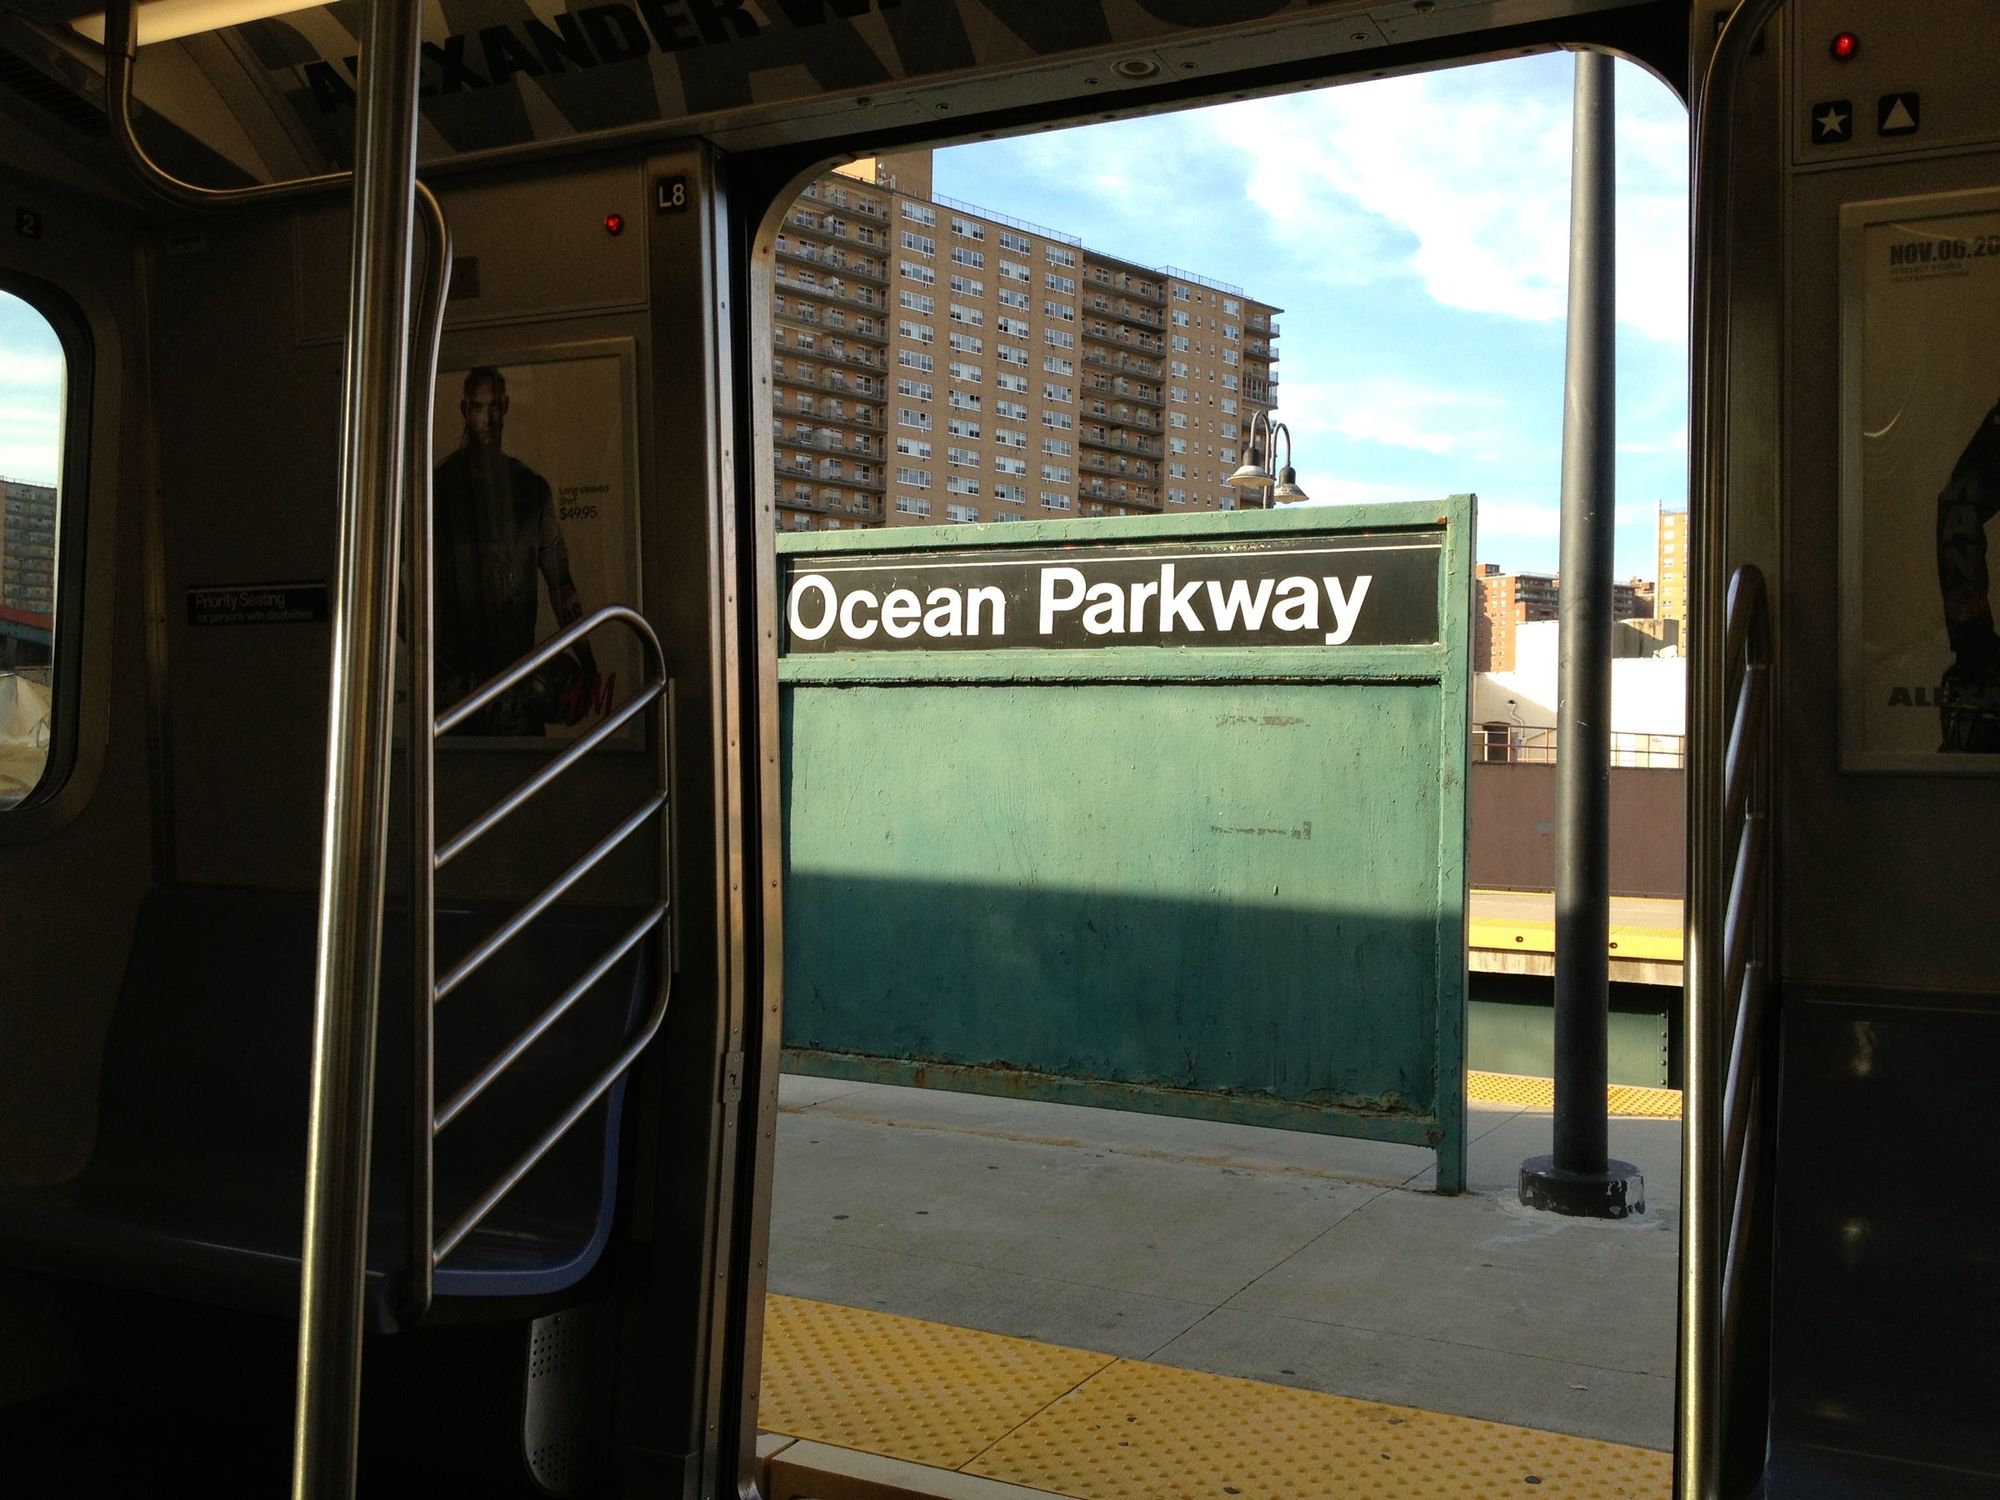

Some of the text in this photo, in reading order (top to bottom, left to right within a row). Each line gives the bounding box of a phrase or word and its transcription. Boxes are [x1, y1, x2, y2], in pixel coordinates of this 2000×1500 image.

[304, 0, 762, 114] AXANDER
[658, 183, 686, 208] L8
[21, 214, 35, 234] 2
[559, 506, 598, 520] $49.95
[195, 591, 286, 610] Priority Seating
[787, 562, 1374, 646] Ocean Parkway
